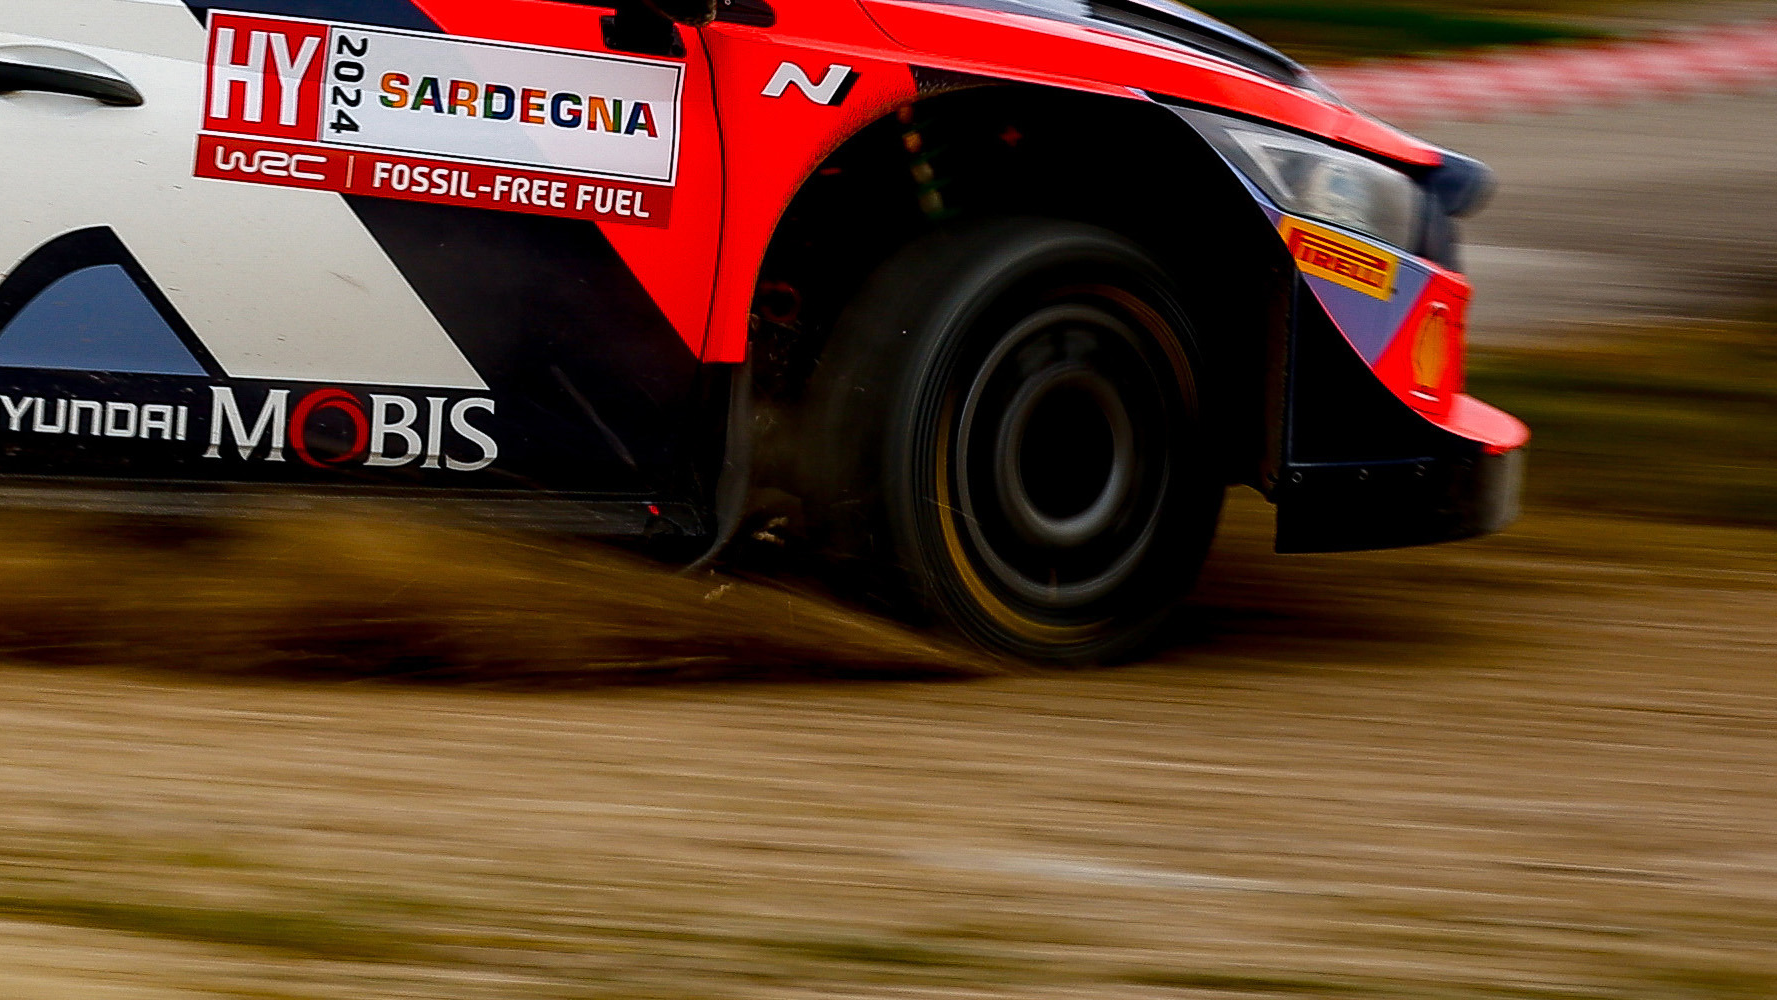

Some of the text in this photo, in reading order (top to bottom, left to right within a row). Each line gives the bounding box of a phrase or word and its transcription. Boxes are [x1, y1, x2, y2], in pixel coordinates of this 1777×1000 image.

[209, 27, 321, 127] HY
[330, 34, 369, 134] 2024
[379, 72, 659, 139] SARDEGNA
[215, 145, 327, 181] WRC
[373, 162, 650, 218] FOSSIL-FREE FUEL
[203, 385, 498, 471] MOBIS
